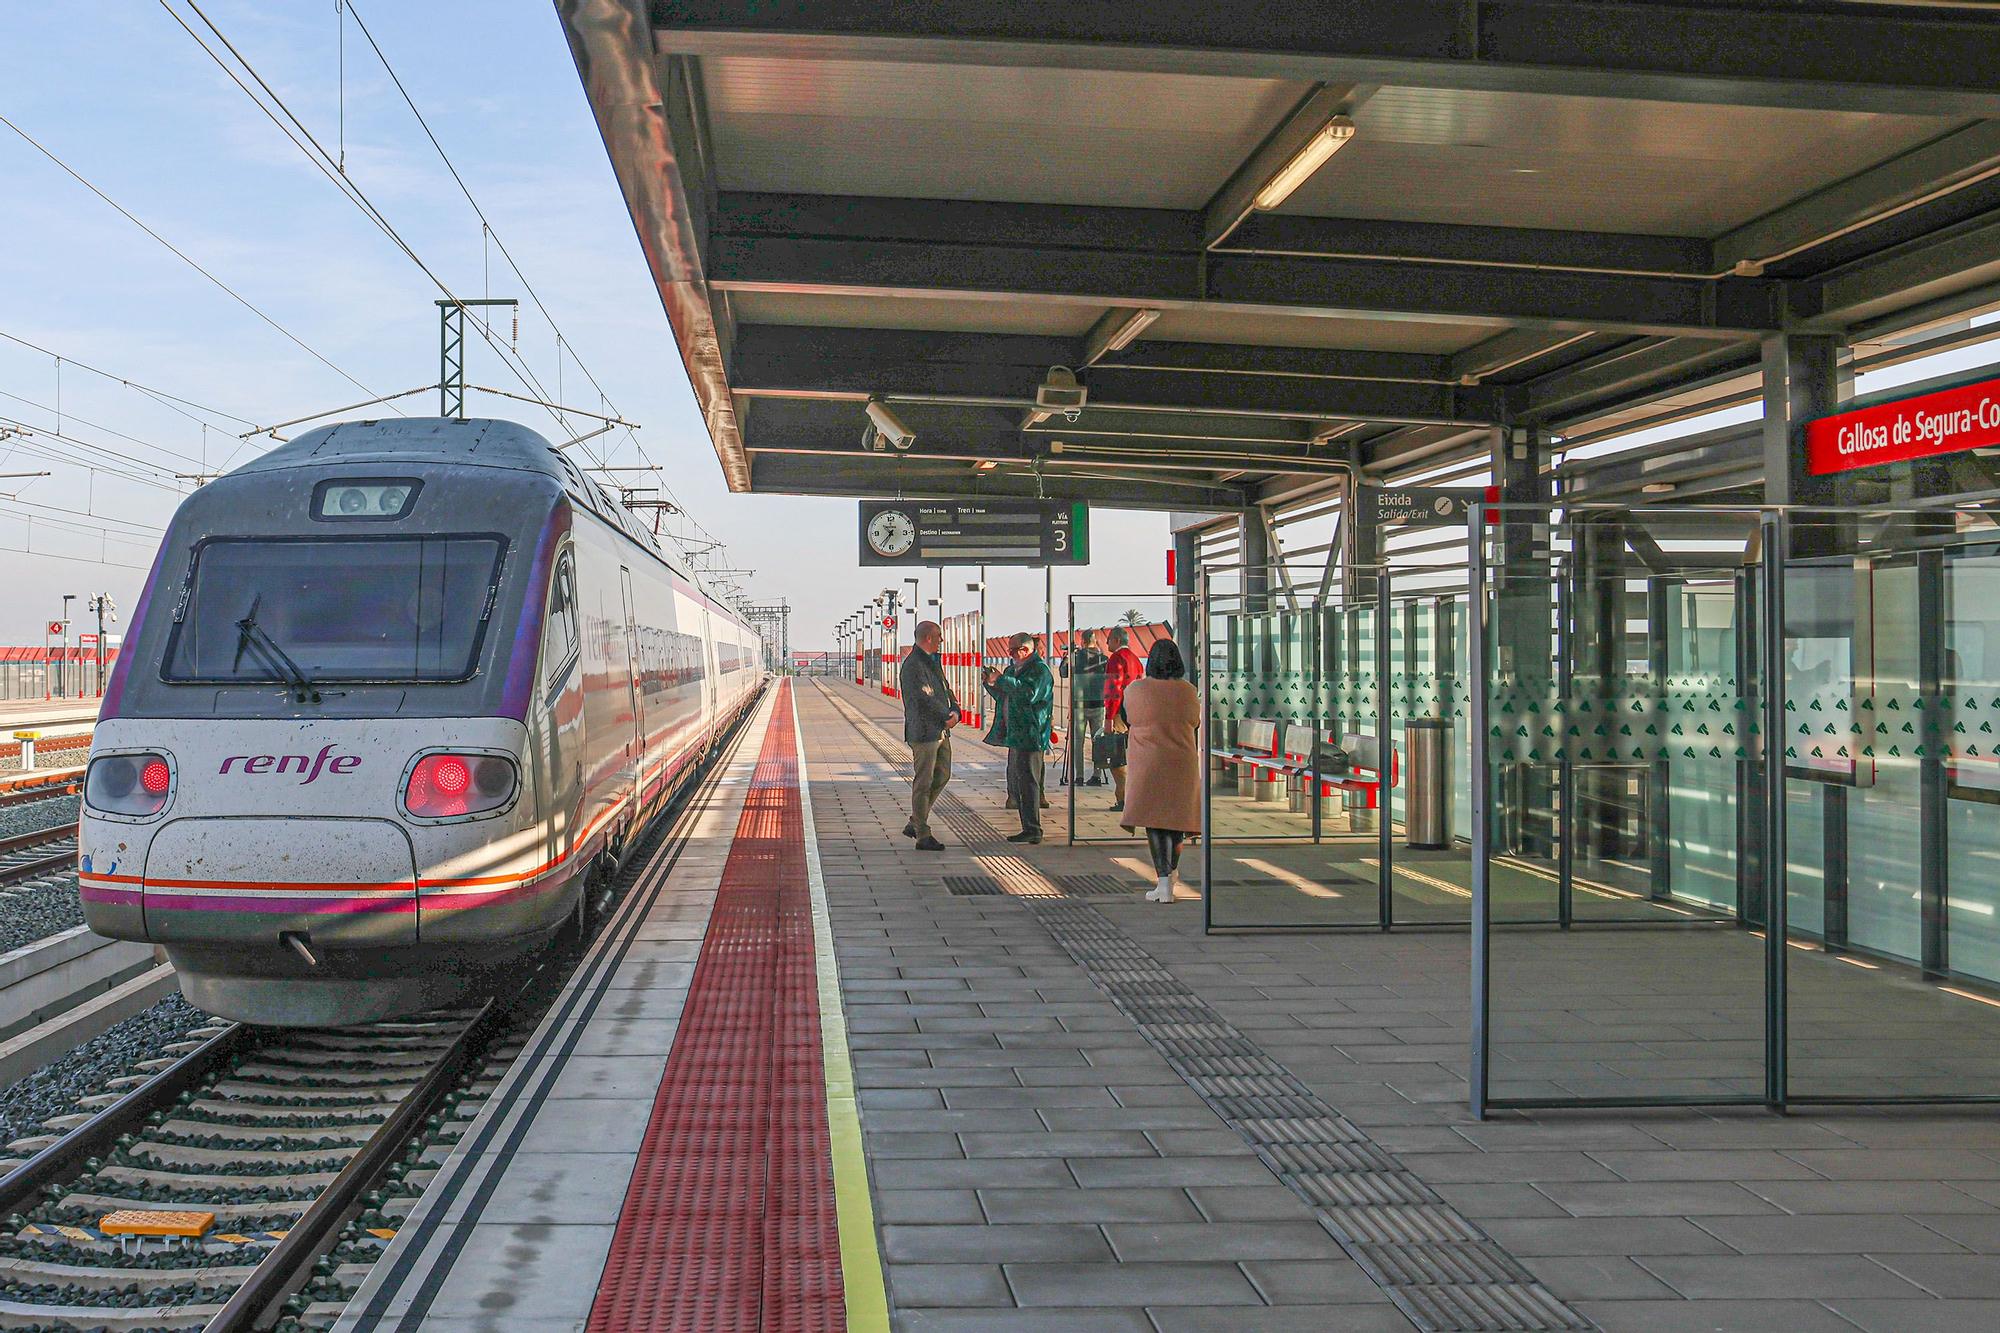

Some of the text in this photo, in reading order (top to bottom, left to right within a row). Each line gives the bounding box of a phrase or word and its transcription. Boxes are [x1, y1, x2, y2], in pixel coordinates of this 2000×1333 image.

[1837, 422, 1888, 455] Callosa
[1892, 414, 1911, 445] de
[1377, 493, 1412, 506] Eixida
[1377, 508, 1429, 520] Salida/Exit
[1054, 529, 1067, 552] 3
[53, 624, 60, 633] 4
[886, 618, 892, 627] 3
[218, 743, 363, 786] renfe
